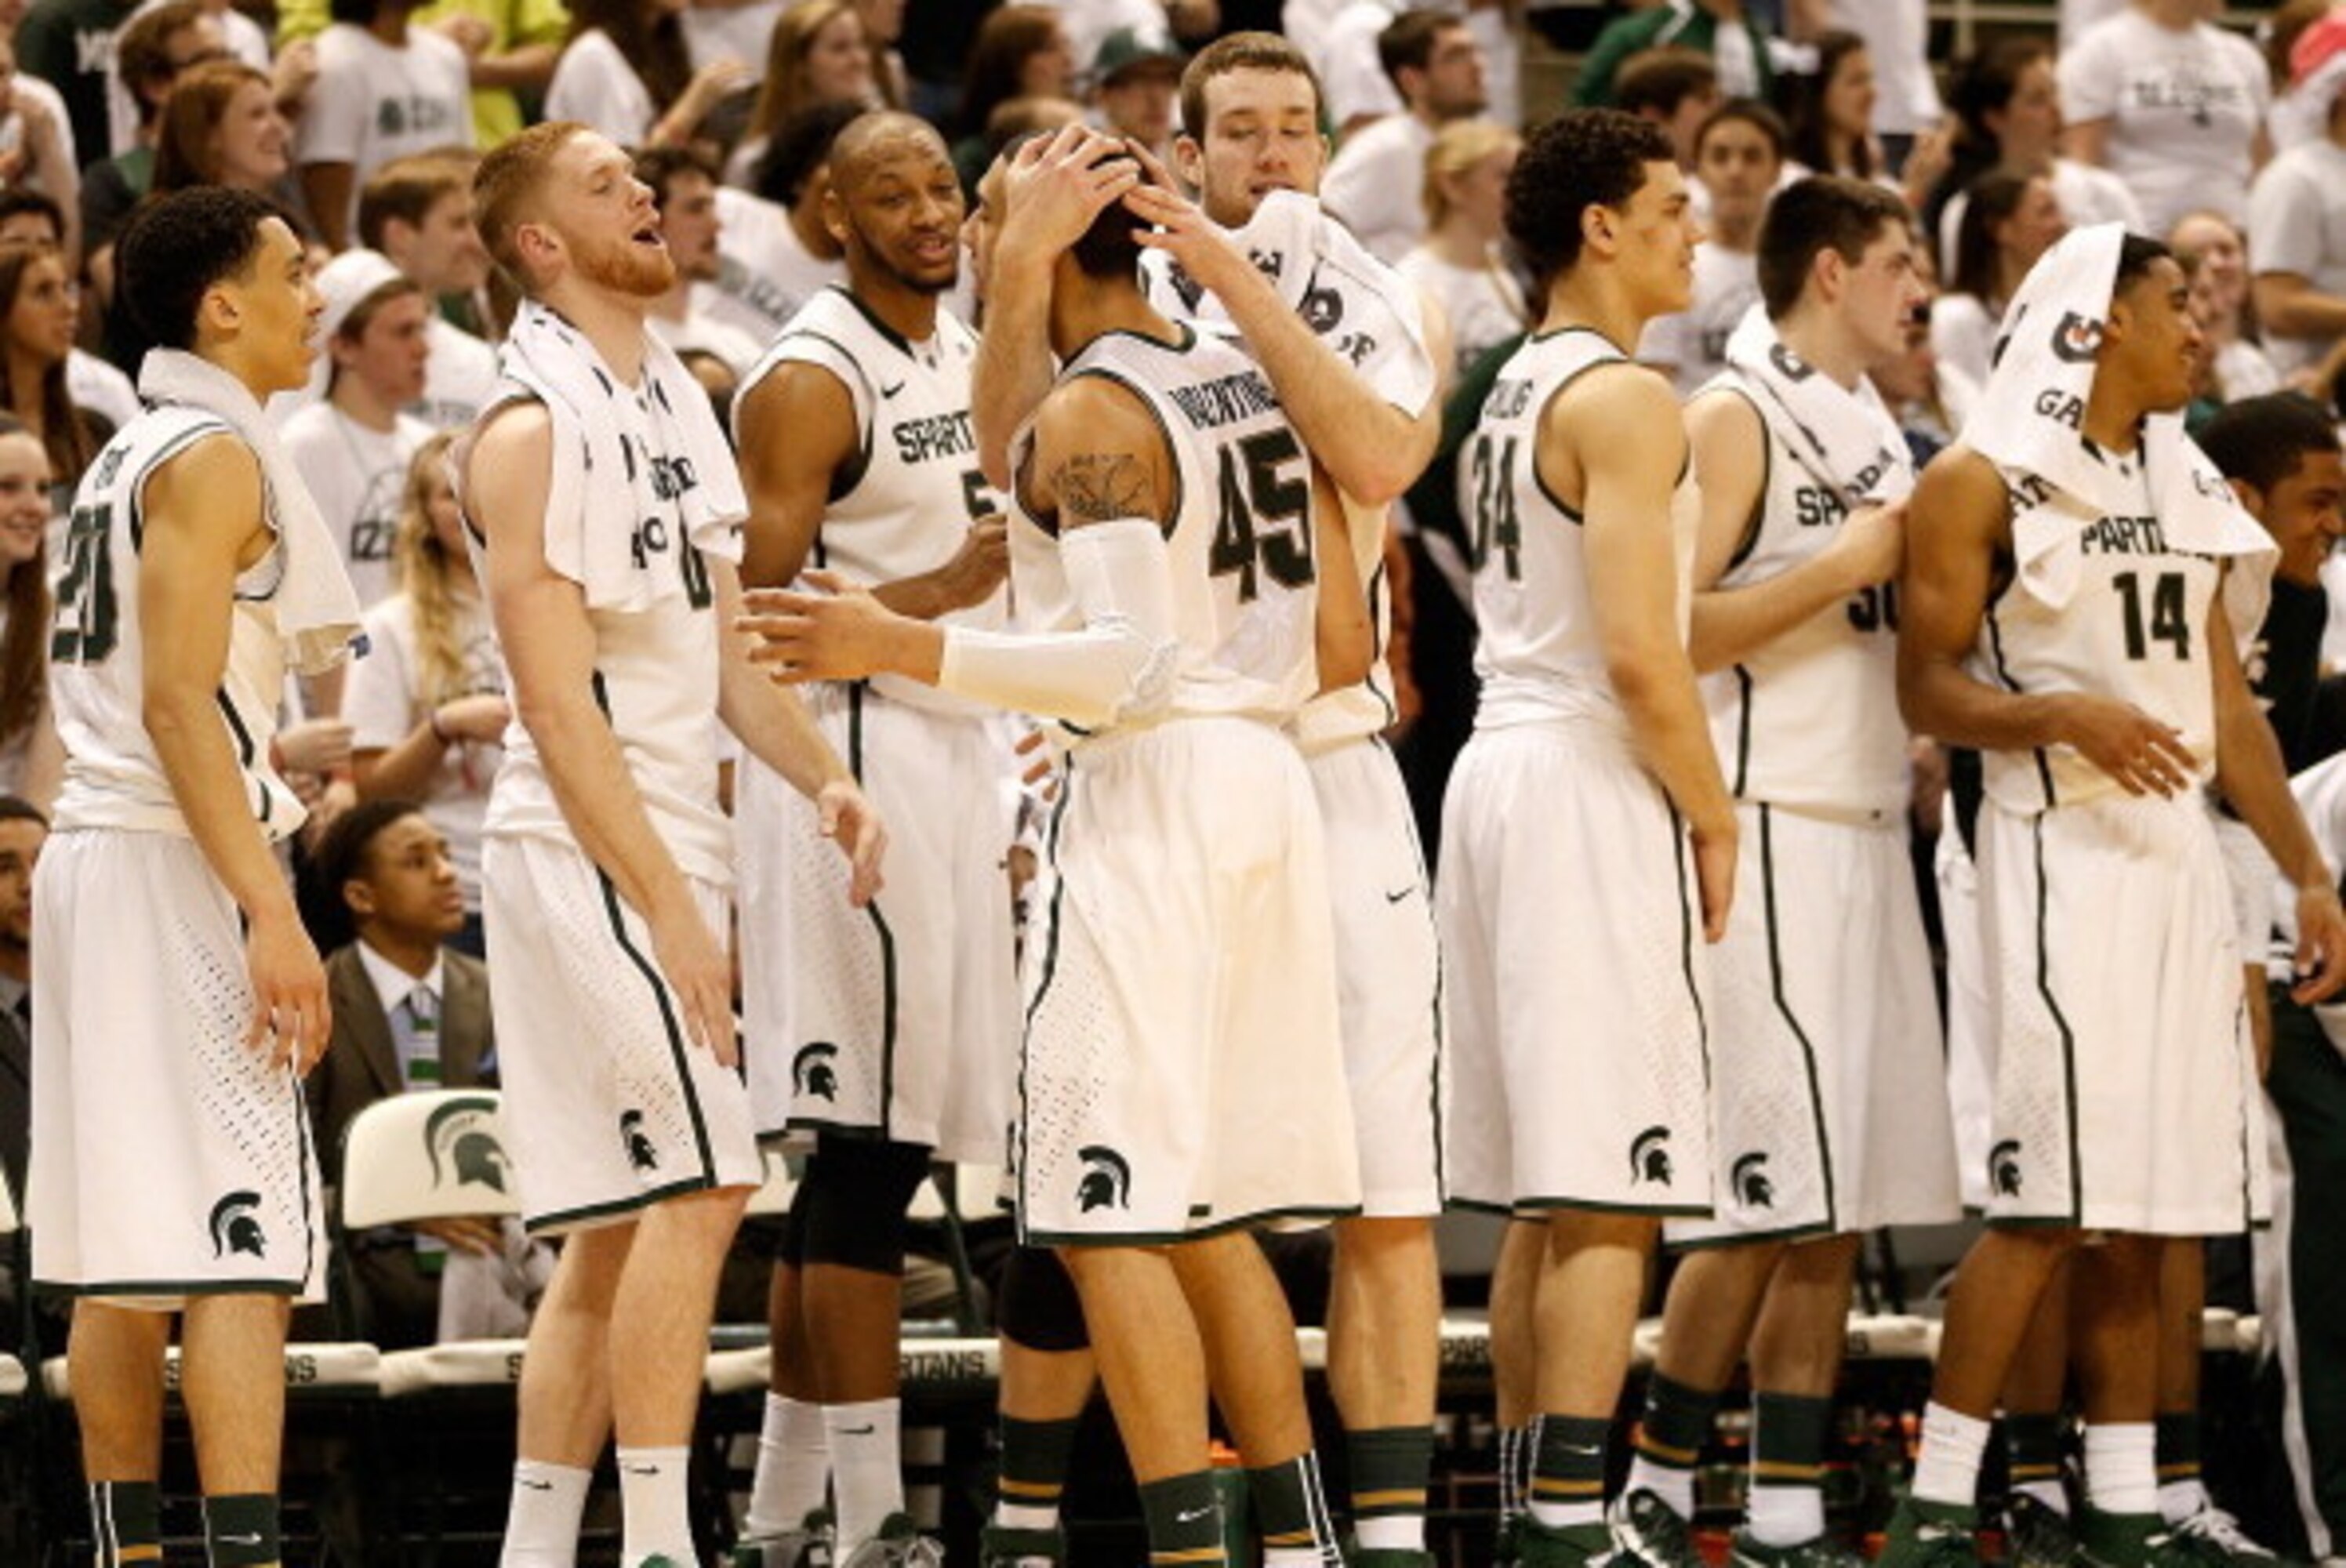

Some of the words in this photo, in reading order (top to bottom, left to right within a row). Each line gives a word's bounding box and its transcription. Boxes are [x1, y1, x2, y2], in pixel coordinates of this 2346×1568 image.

[51, 504, 118, 666] 20
[1208, 426, 1316, 604] 45
[2112, 572, 2190, 660] 14
